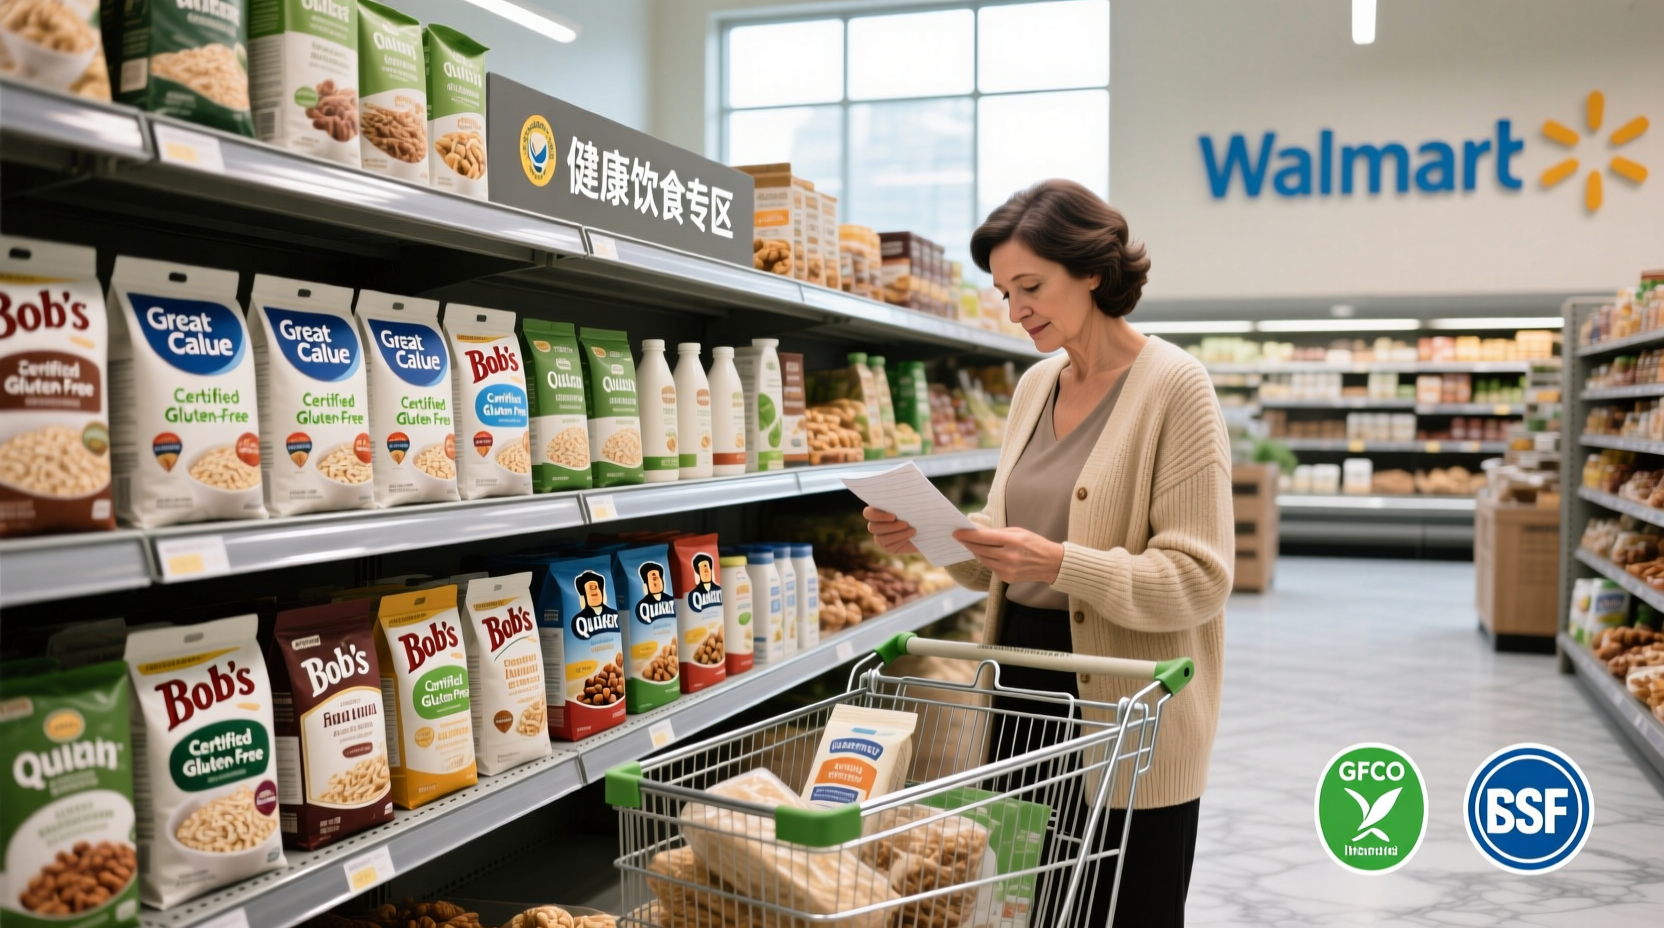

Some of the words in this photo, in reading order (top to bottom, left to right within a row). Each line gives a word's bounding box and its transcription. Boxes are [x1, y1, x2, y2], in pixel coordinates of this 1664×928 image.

[1199, 119, 1525, 199] Walmart
[567, 135, 734, 239] 健康饮食专区
[147, 306, 212, 333] Great
[279, 319, 331, 342] Great
[381, 330, 424, 351] Great
[465, 346, 519, 384] Bob's
[174, 387, 240, 404] Certified
[401, 396, 446, 411] Certified
[165, 406, 249, 424] Gluten-Free
[482, 606, 534, 653] Bob's
[399, 621, 459, 674] Bob's
[301, 644, 370, 698] Bob's
[154, 660, 256, 732] Bob's
[189, 728, 253, 756] Certified
[235, 746, 264, 766] Free
